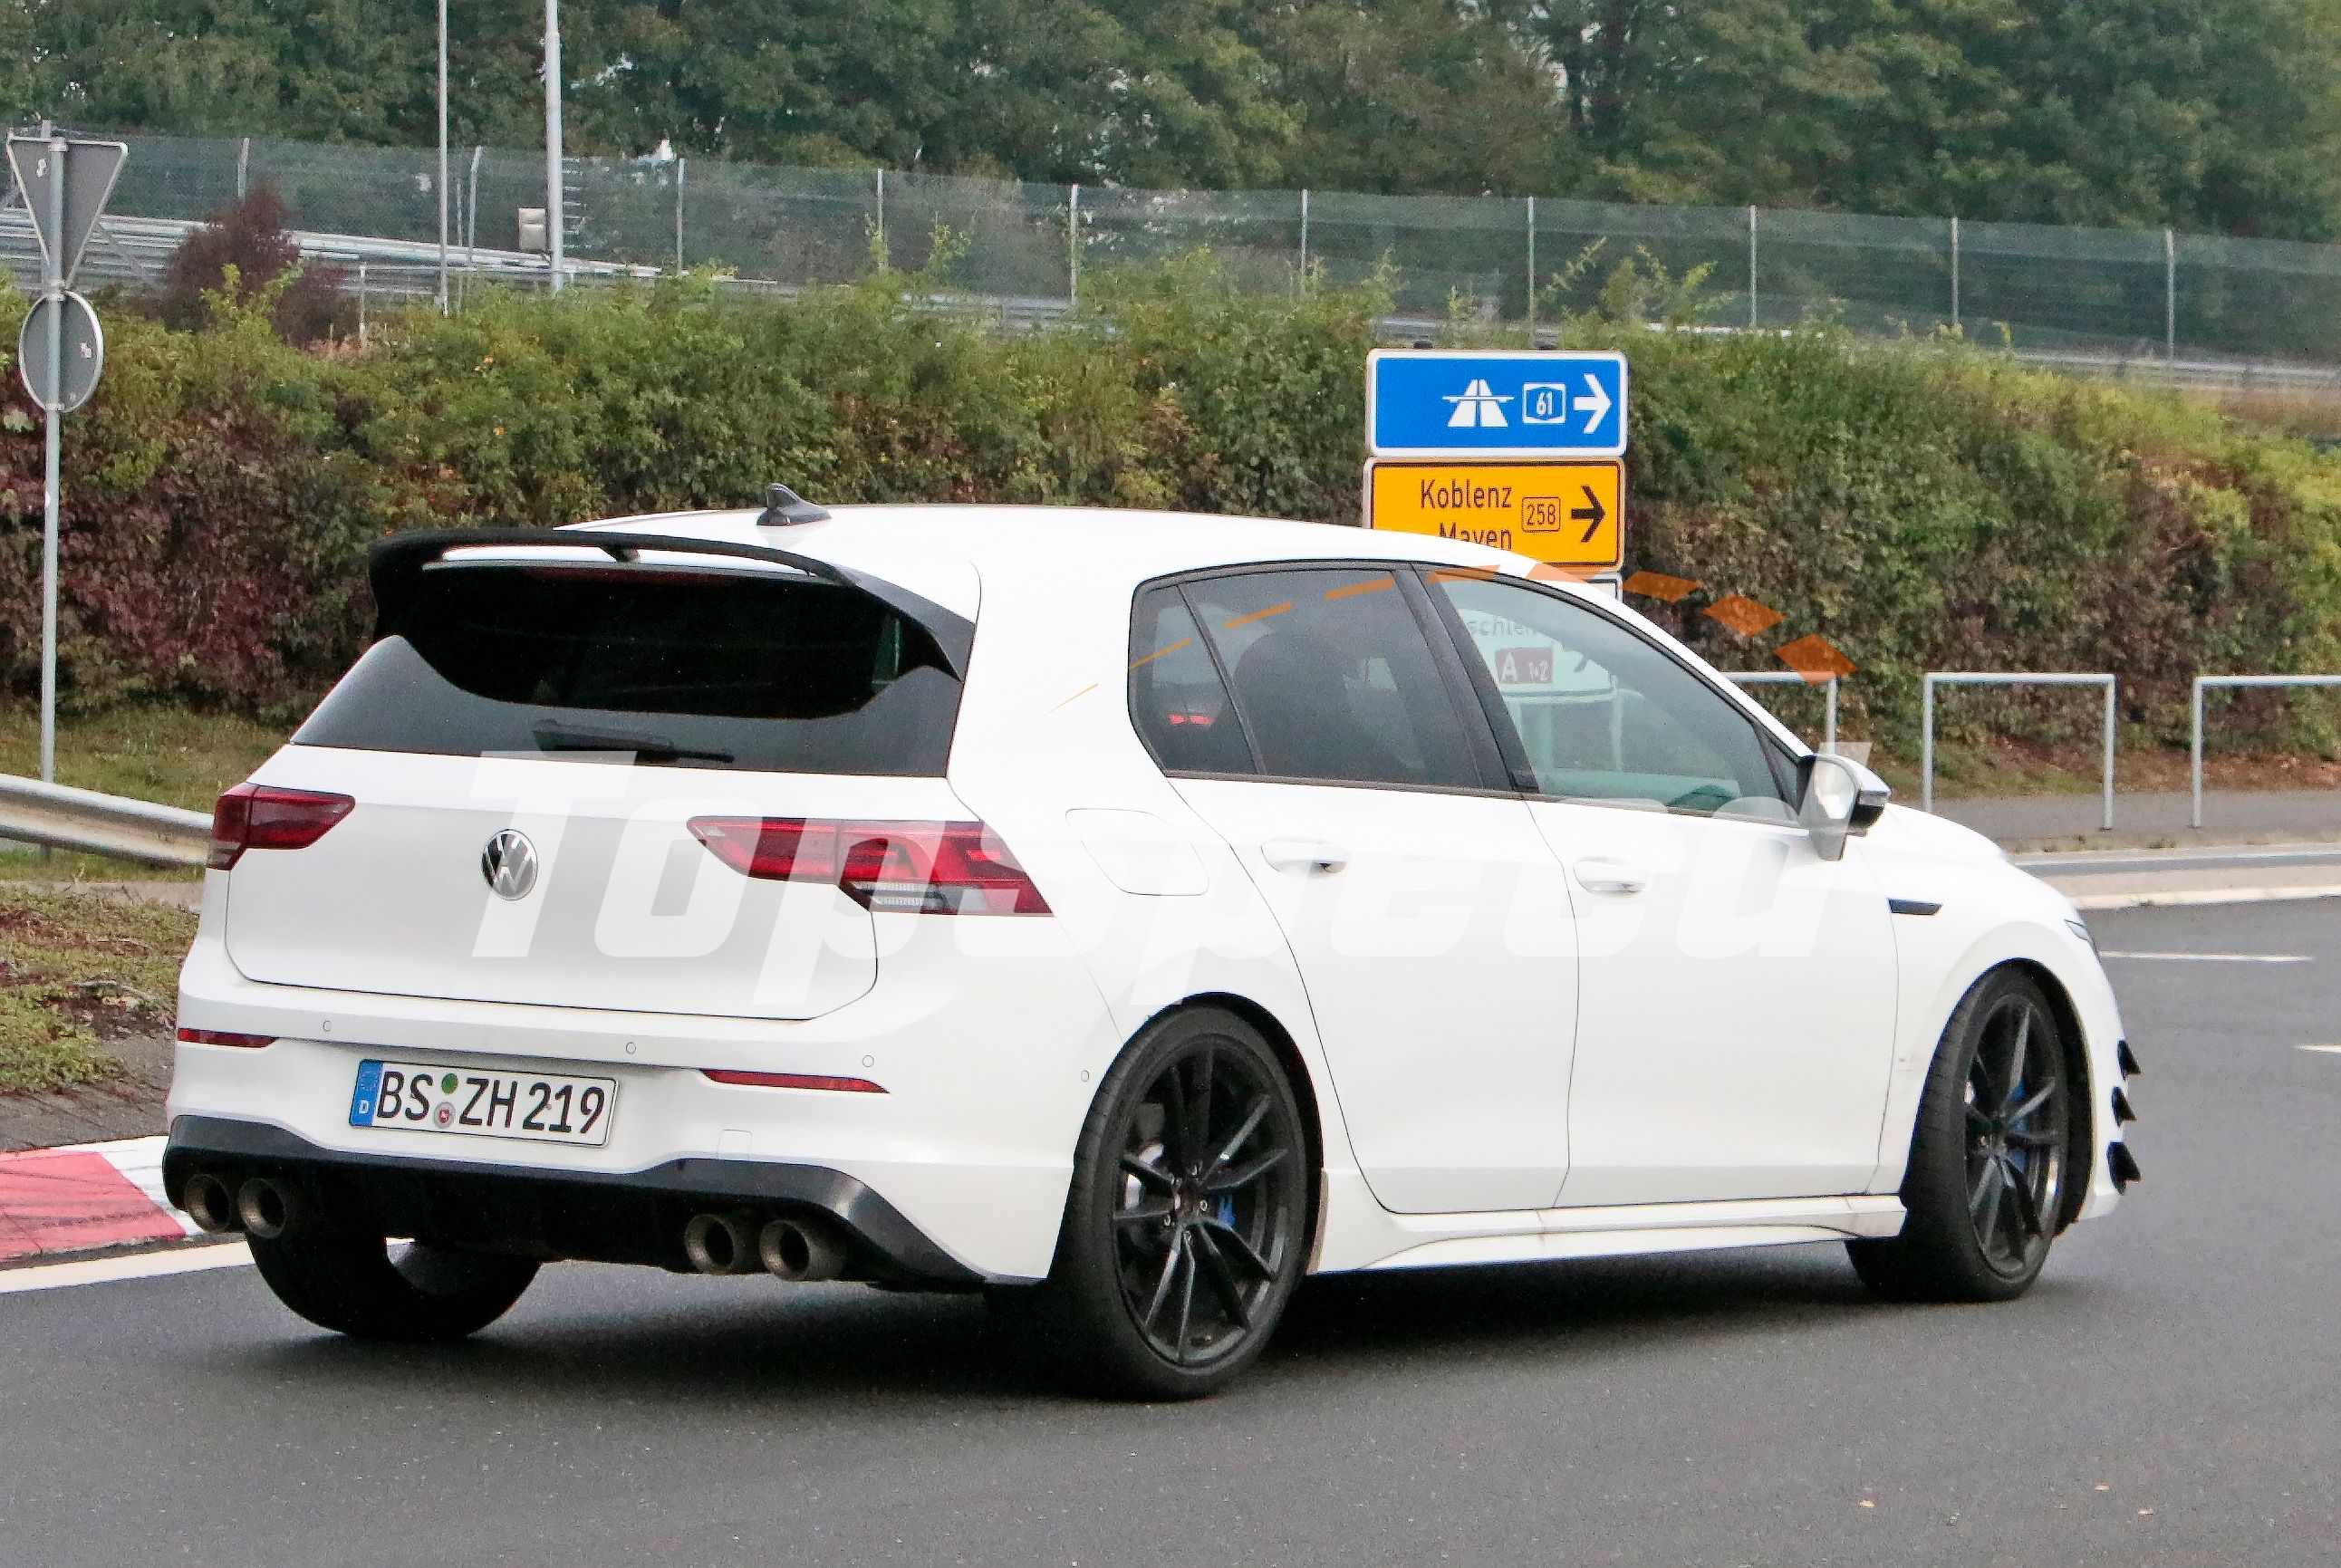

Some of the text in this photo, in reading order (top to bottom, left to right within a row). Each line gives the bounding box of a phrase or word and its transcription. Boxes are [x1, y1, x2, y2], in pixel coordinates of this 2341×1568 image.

[1536, 390, 1553, 415] 61
[1421, 478, 1512, 508] Koblenz
[1526, 503, 1556, 525] 258
[1500, 651, 1518, 682] A
[358, 1071, 605, 1133] D BS ZH 219
